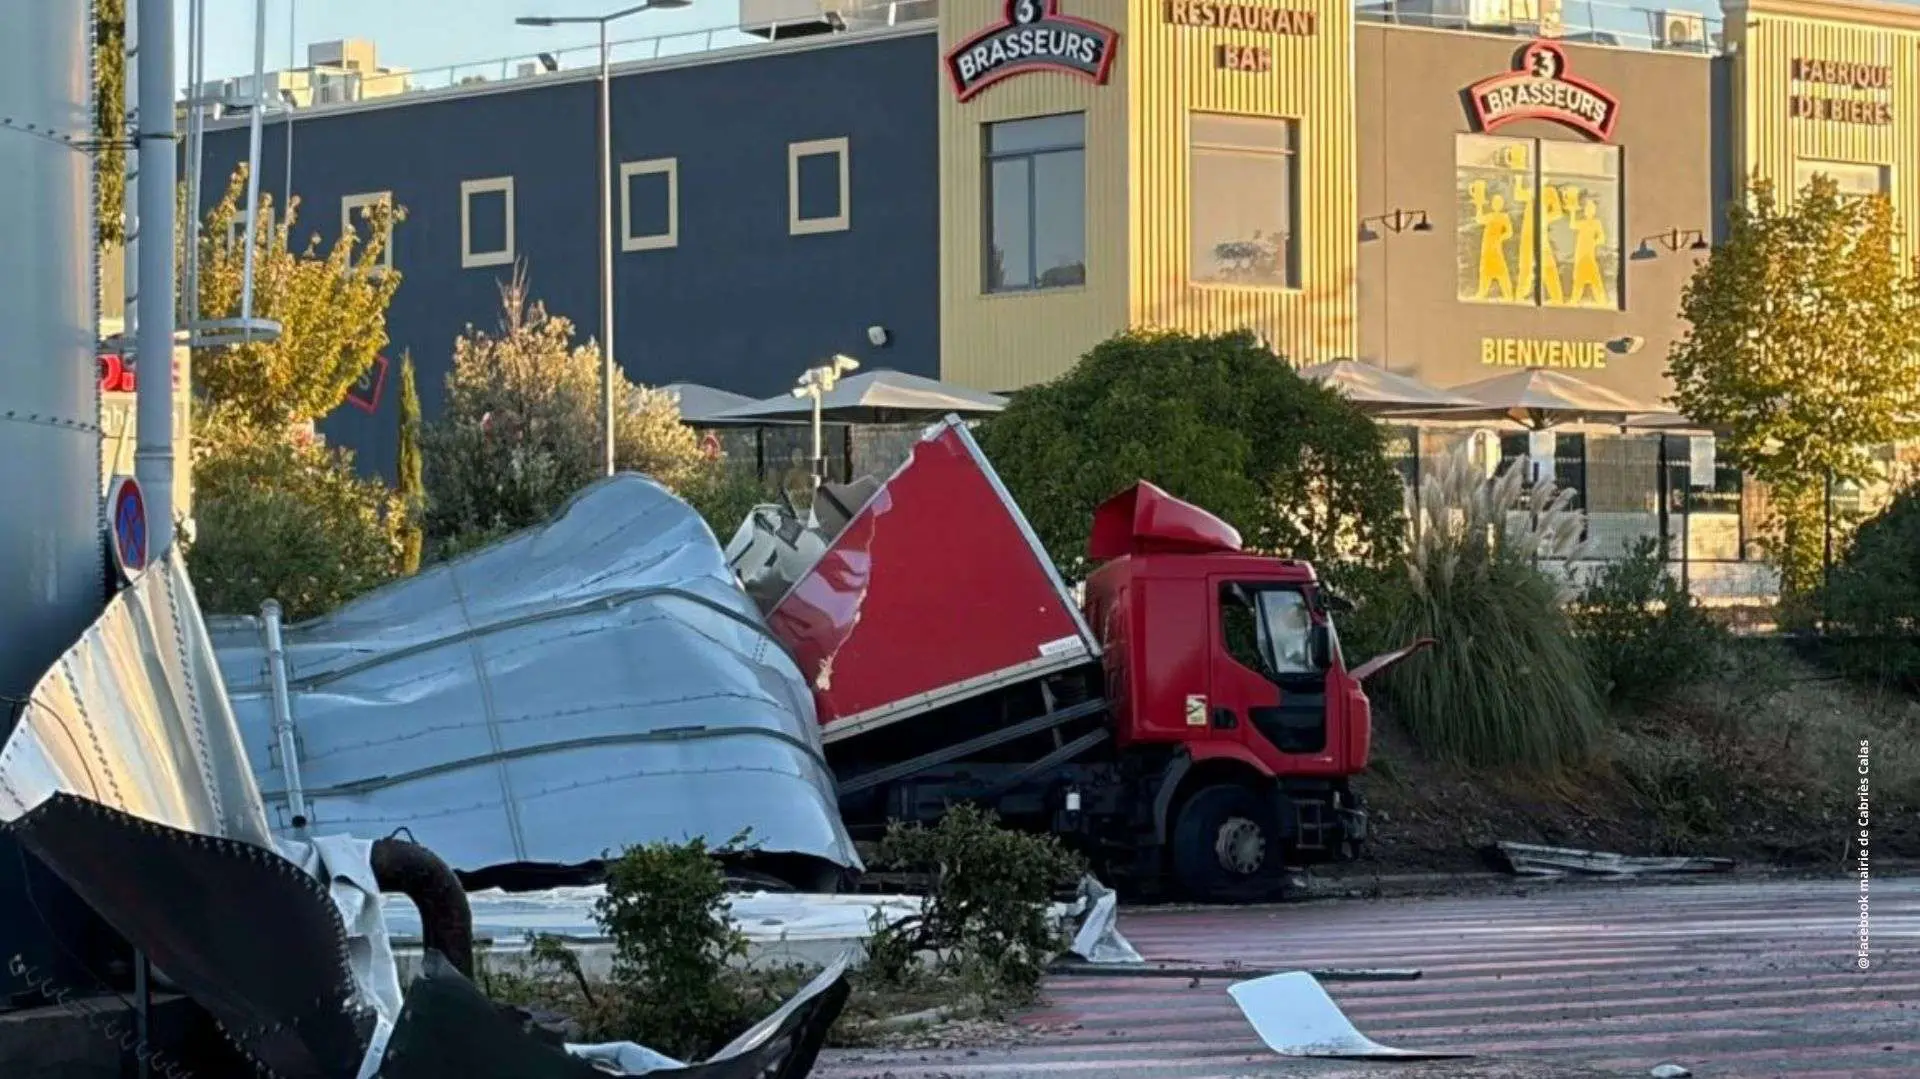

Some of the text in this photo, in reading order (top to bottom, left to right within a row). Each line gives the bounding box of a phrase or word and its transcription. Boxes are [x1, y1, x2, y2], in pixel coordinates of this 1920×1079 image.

[1016, 0, 1034, 23] 3
[1172, 0, 1318, 36] RESTAURANT
[957, 28, 1096, 81] BRASSEURS
[1225, 46, 1272, 72] BAR
[1533, 49, 1556, 79] 3
[1800, 57, 1893, 89] FABRIQUE
[1488, 82, 1608, 126] BRASSEURS
[1481, 337, 1607, 369] BIENVENUE
